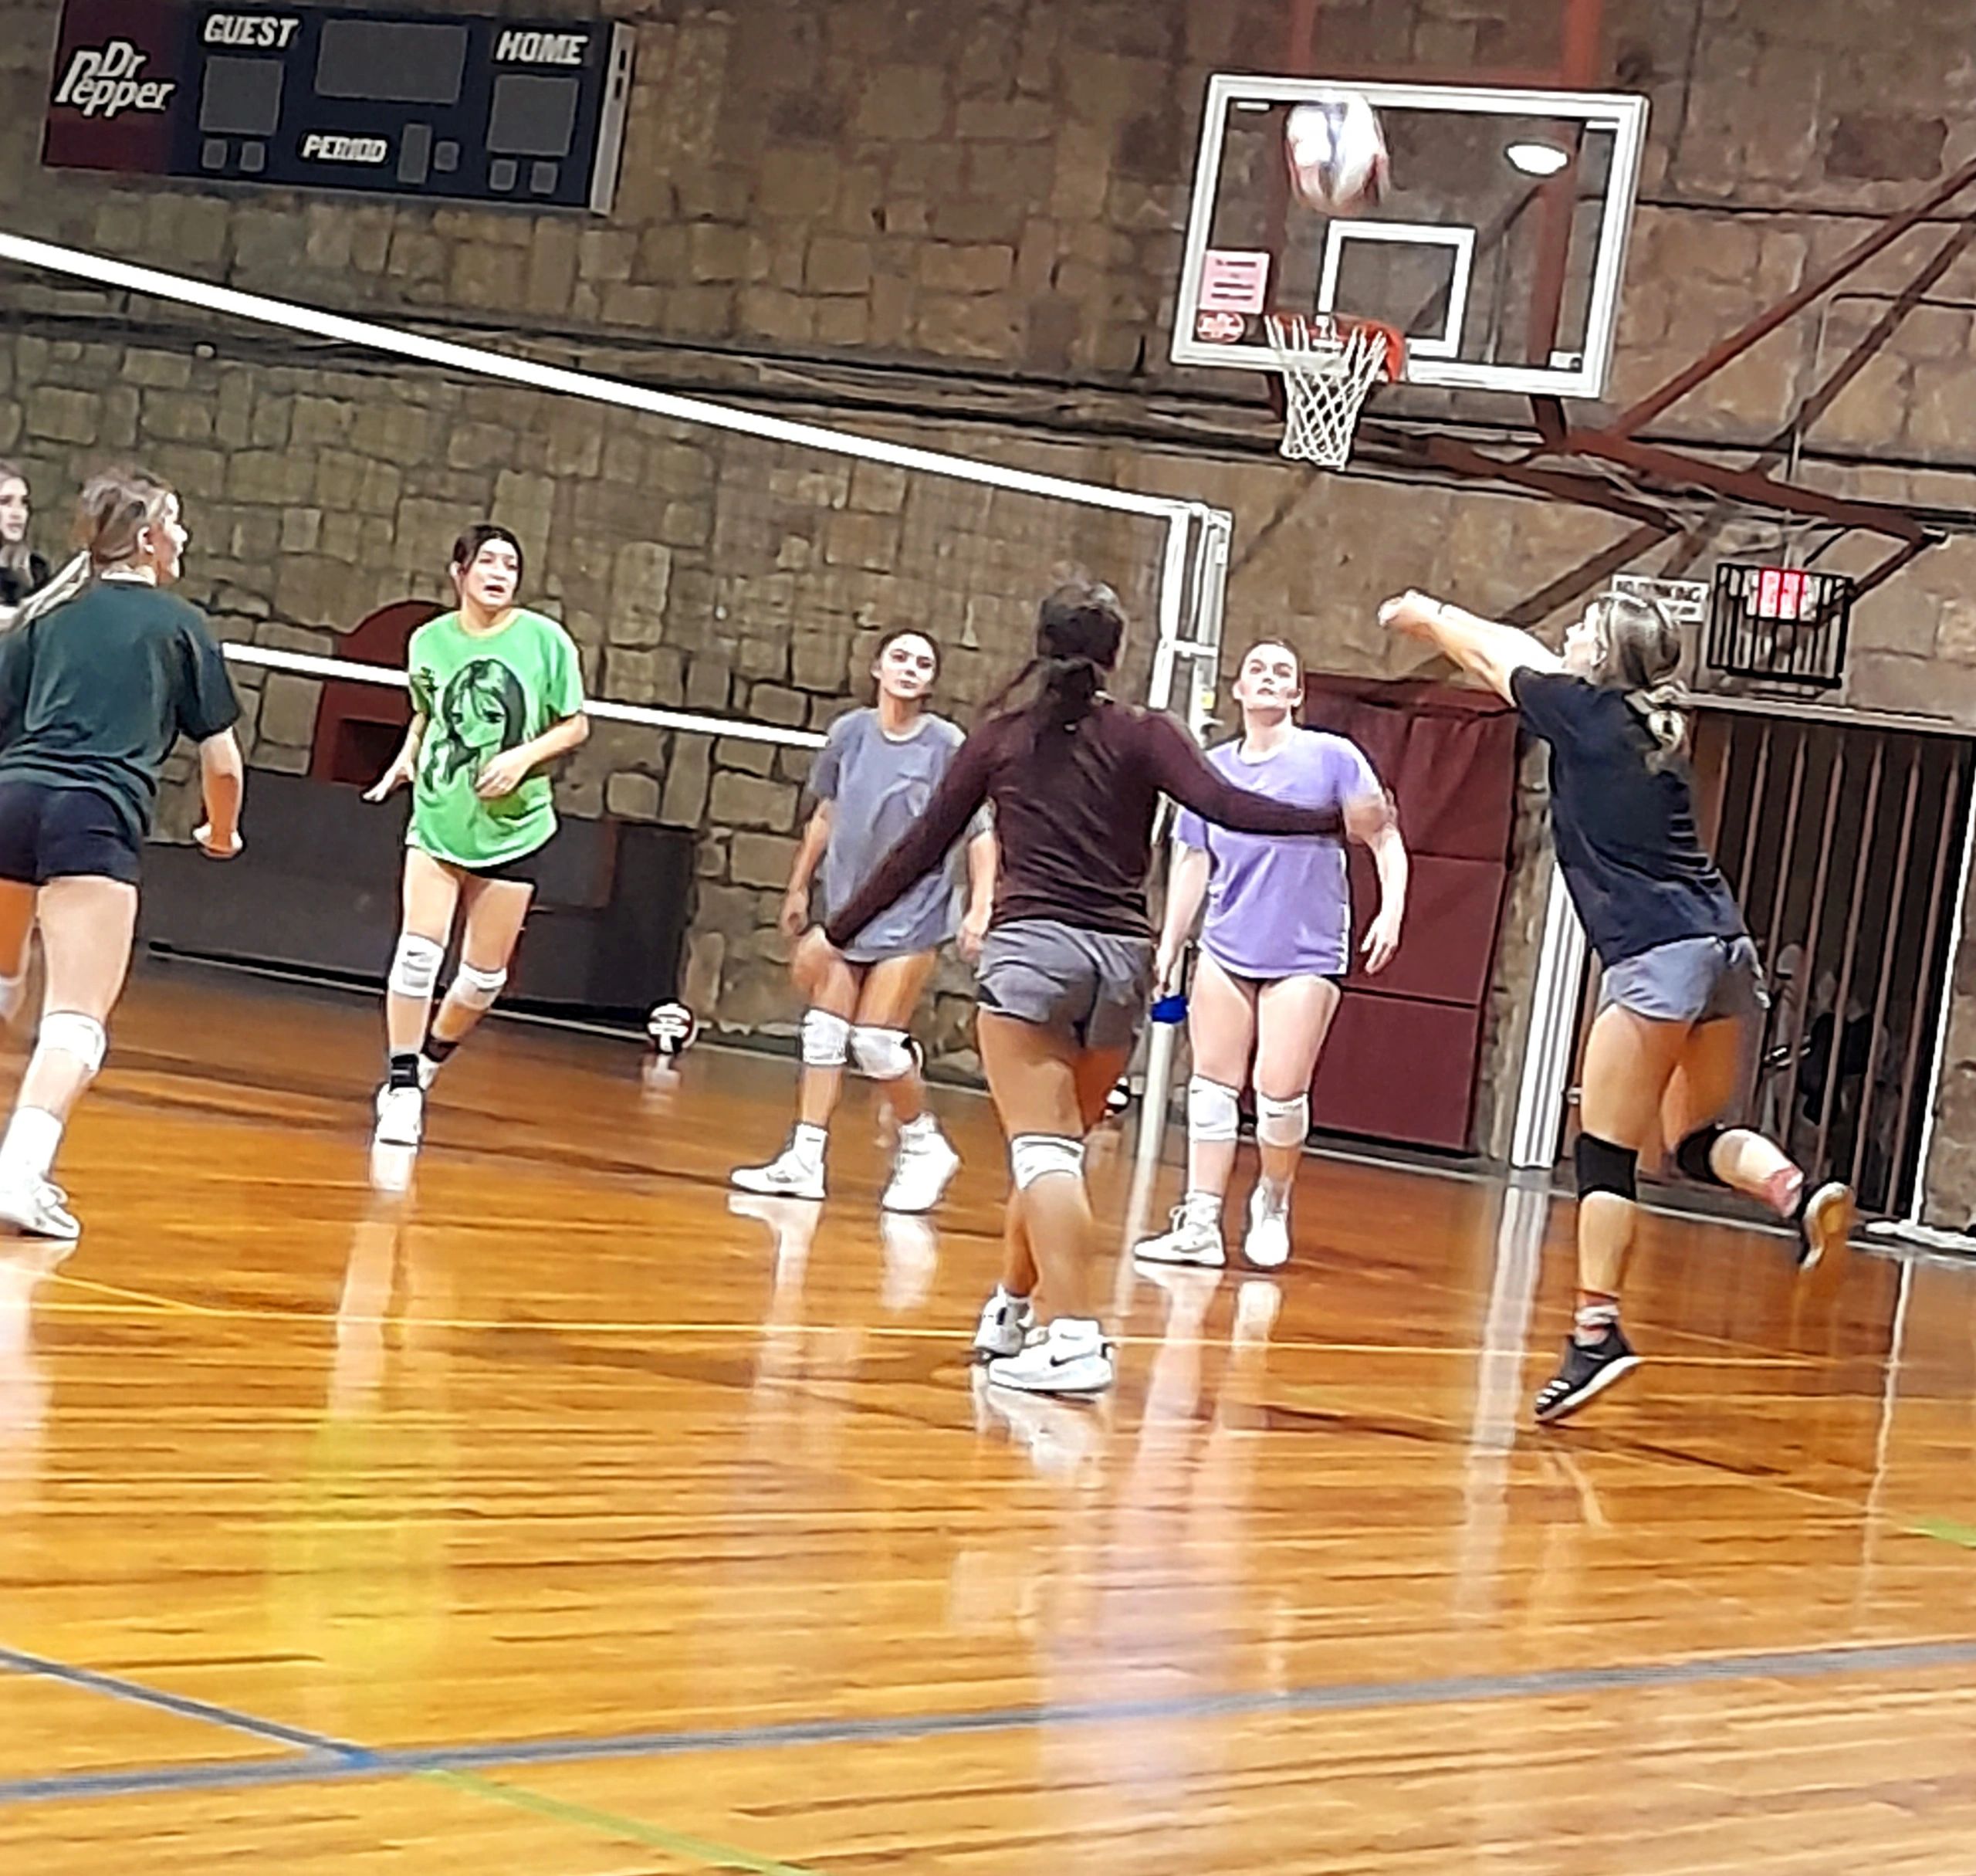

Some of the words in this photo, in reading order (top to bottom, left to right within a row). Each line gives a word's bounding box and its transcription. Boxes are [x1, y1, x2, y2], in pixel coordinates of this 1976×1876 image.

[204, 14, 299, 47] GUEST
[496, 30, 588, 65] HOME
[96, 42, 147, 79] Dr
[55, 50, 175, 117] Pepper
